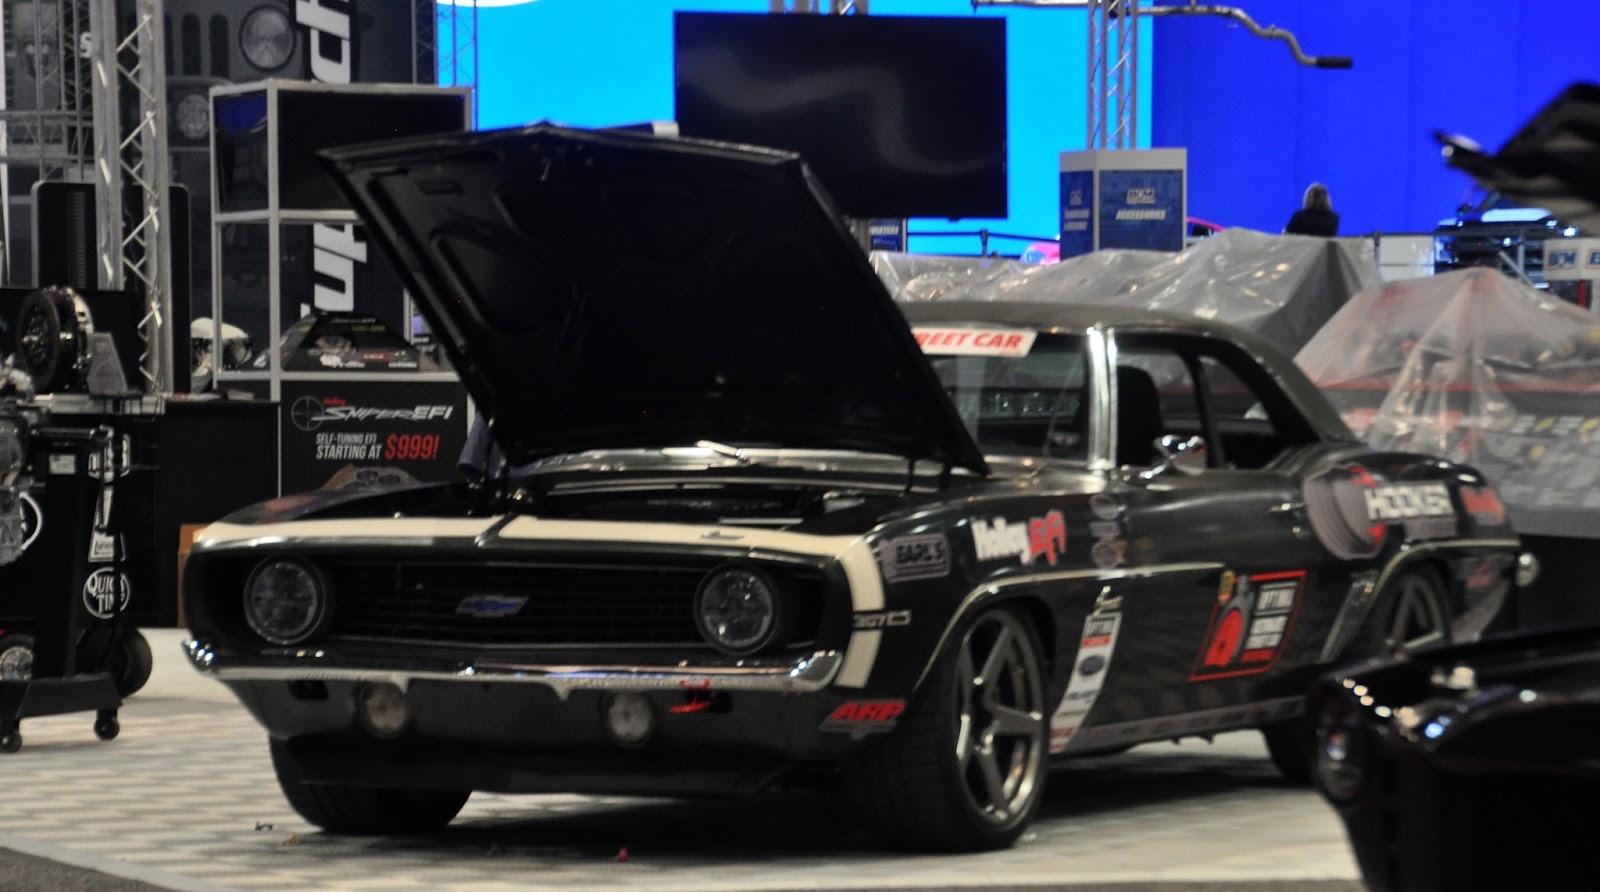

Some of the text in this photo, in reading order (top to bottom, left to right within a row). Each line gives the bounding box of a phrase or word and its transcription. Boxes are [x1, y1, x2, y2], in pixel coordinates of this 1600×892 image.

[868, 225, 900, 236] VERTERS
[915, 331, 1024, 349] REET CAR
[411, 404, 454, 420] EFI
[315, 432, 379, 445] SELF-TUNING EFI
[315, 432, 440, 461] STARTING AT $999!
[830, 700, 906, 722] ARP
